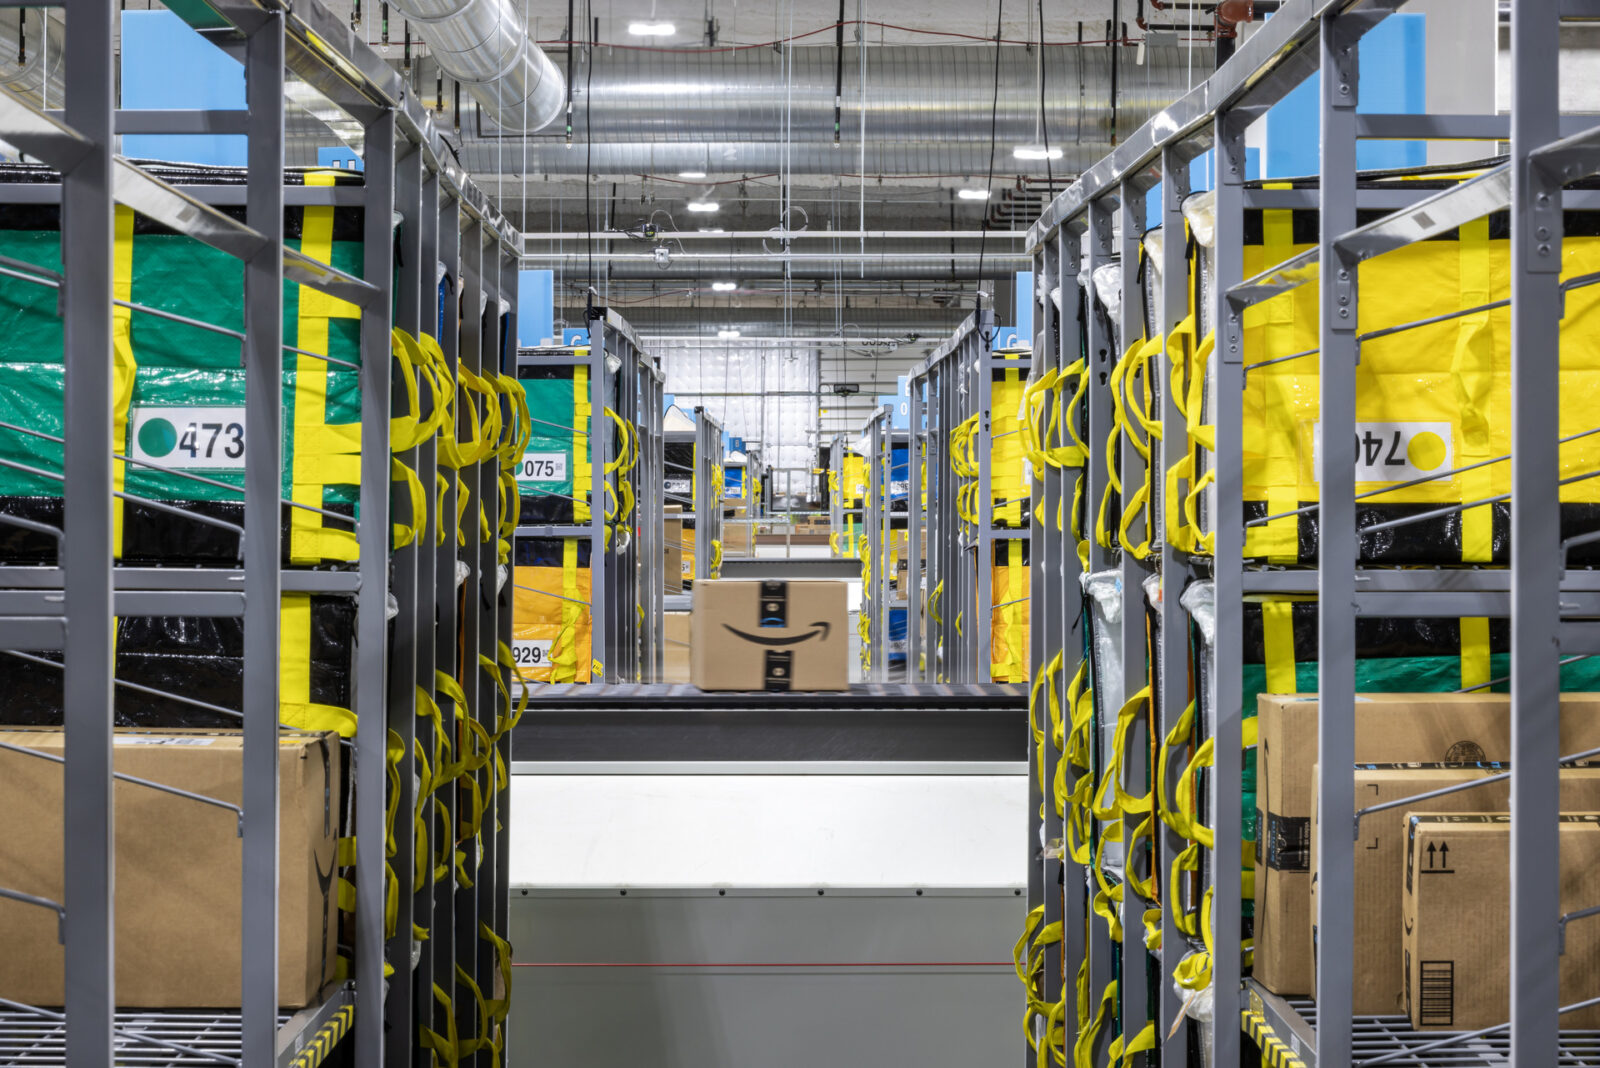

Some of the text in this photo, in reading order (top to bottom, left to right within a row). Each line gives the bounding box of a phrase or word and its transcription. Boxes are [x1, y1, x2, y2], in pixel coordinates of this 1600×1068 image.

[179, 422, 245, 459] 473
[1355, 431, 1406, 466] 74
[524, 460, 554, 477] 075
[512, 646, 542, 664] 929
